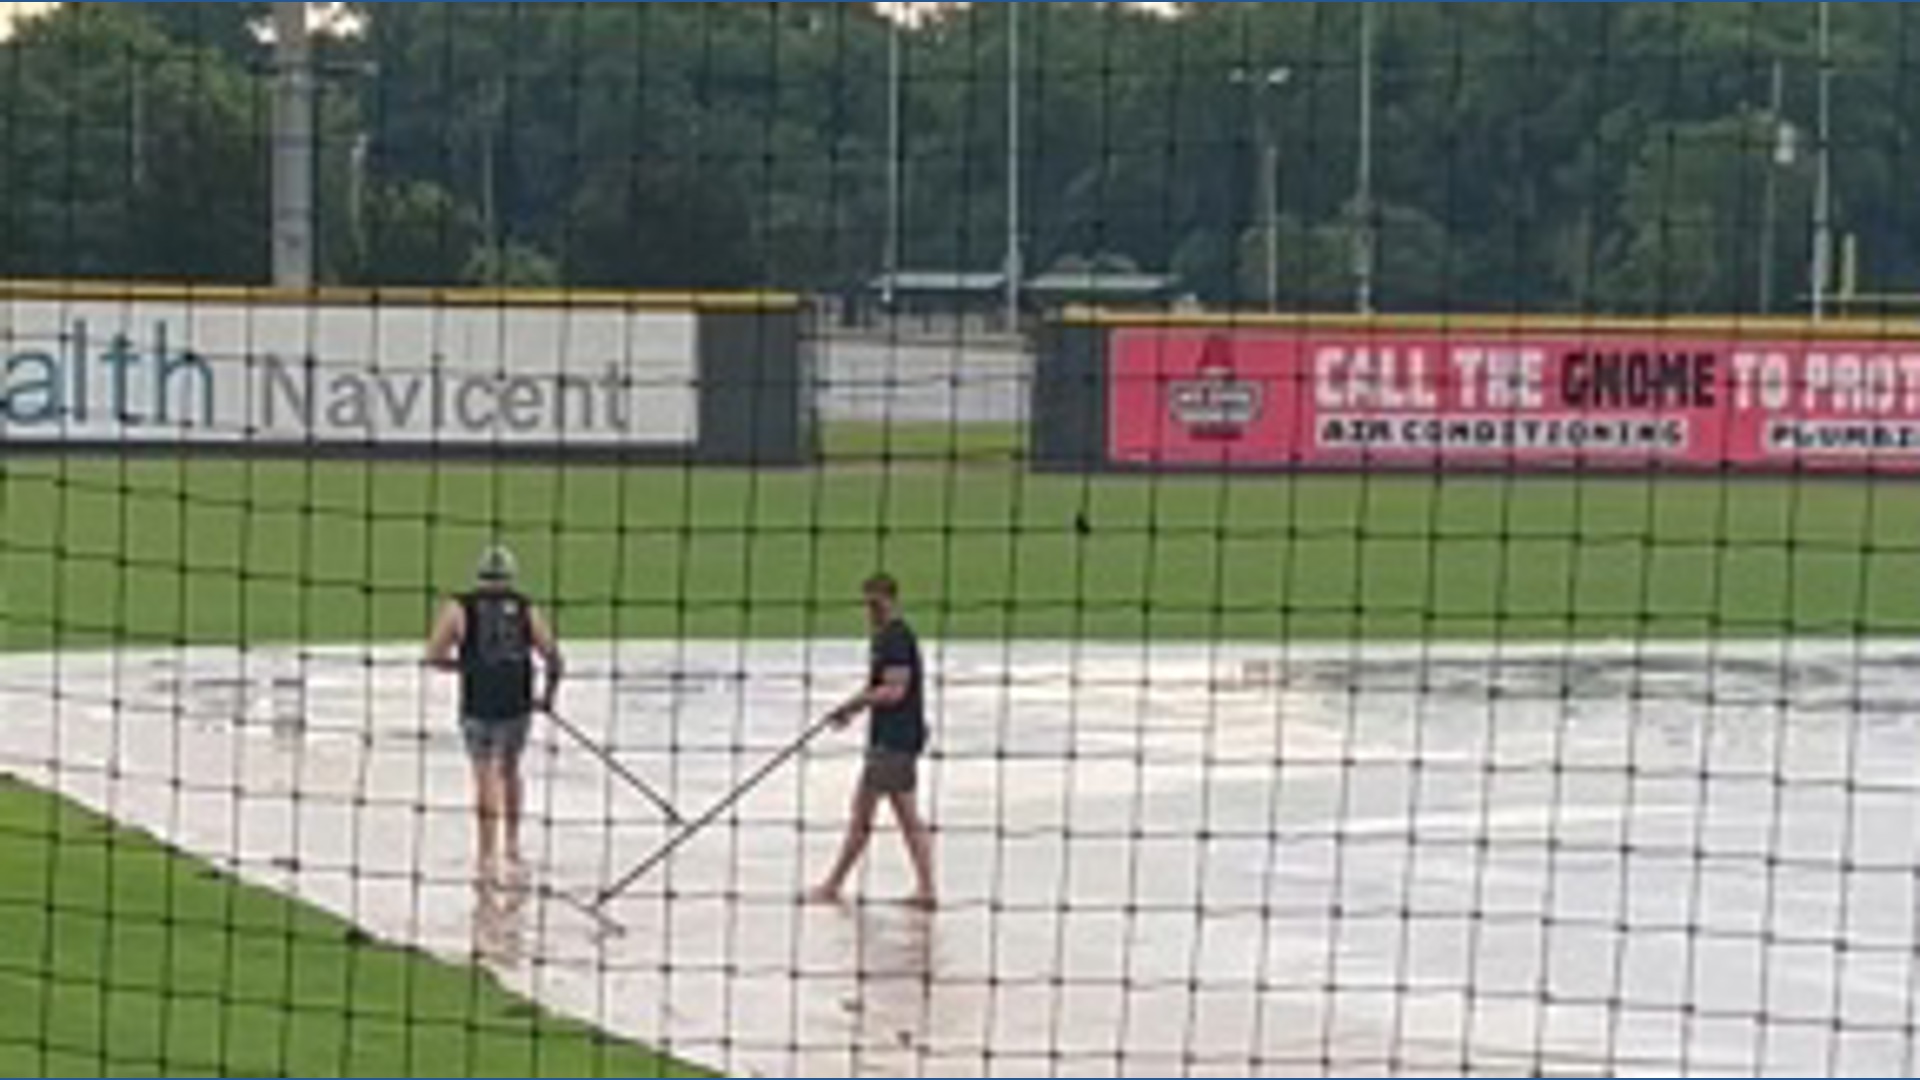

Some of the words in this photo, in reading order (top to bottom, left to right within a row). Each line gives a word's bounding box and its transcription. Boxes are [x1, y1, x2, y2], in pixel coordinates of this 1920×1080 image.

[5, 319, 213, 427] alth
[263, 353, 630, 431] Navicent
[1315, 347, 1436, 408] CALL
[1453, 348, 1543, 409] THE
[1561, 351, 1715, 408] GNOME
[1732, 353, 1788, 409] TO
[1323, 419, 1390, 443] AIR
[1401, 419, 1681, 447] CONDITIONING
